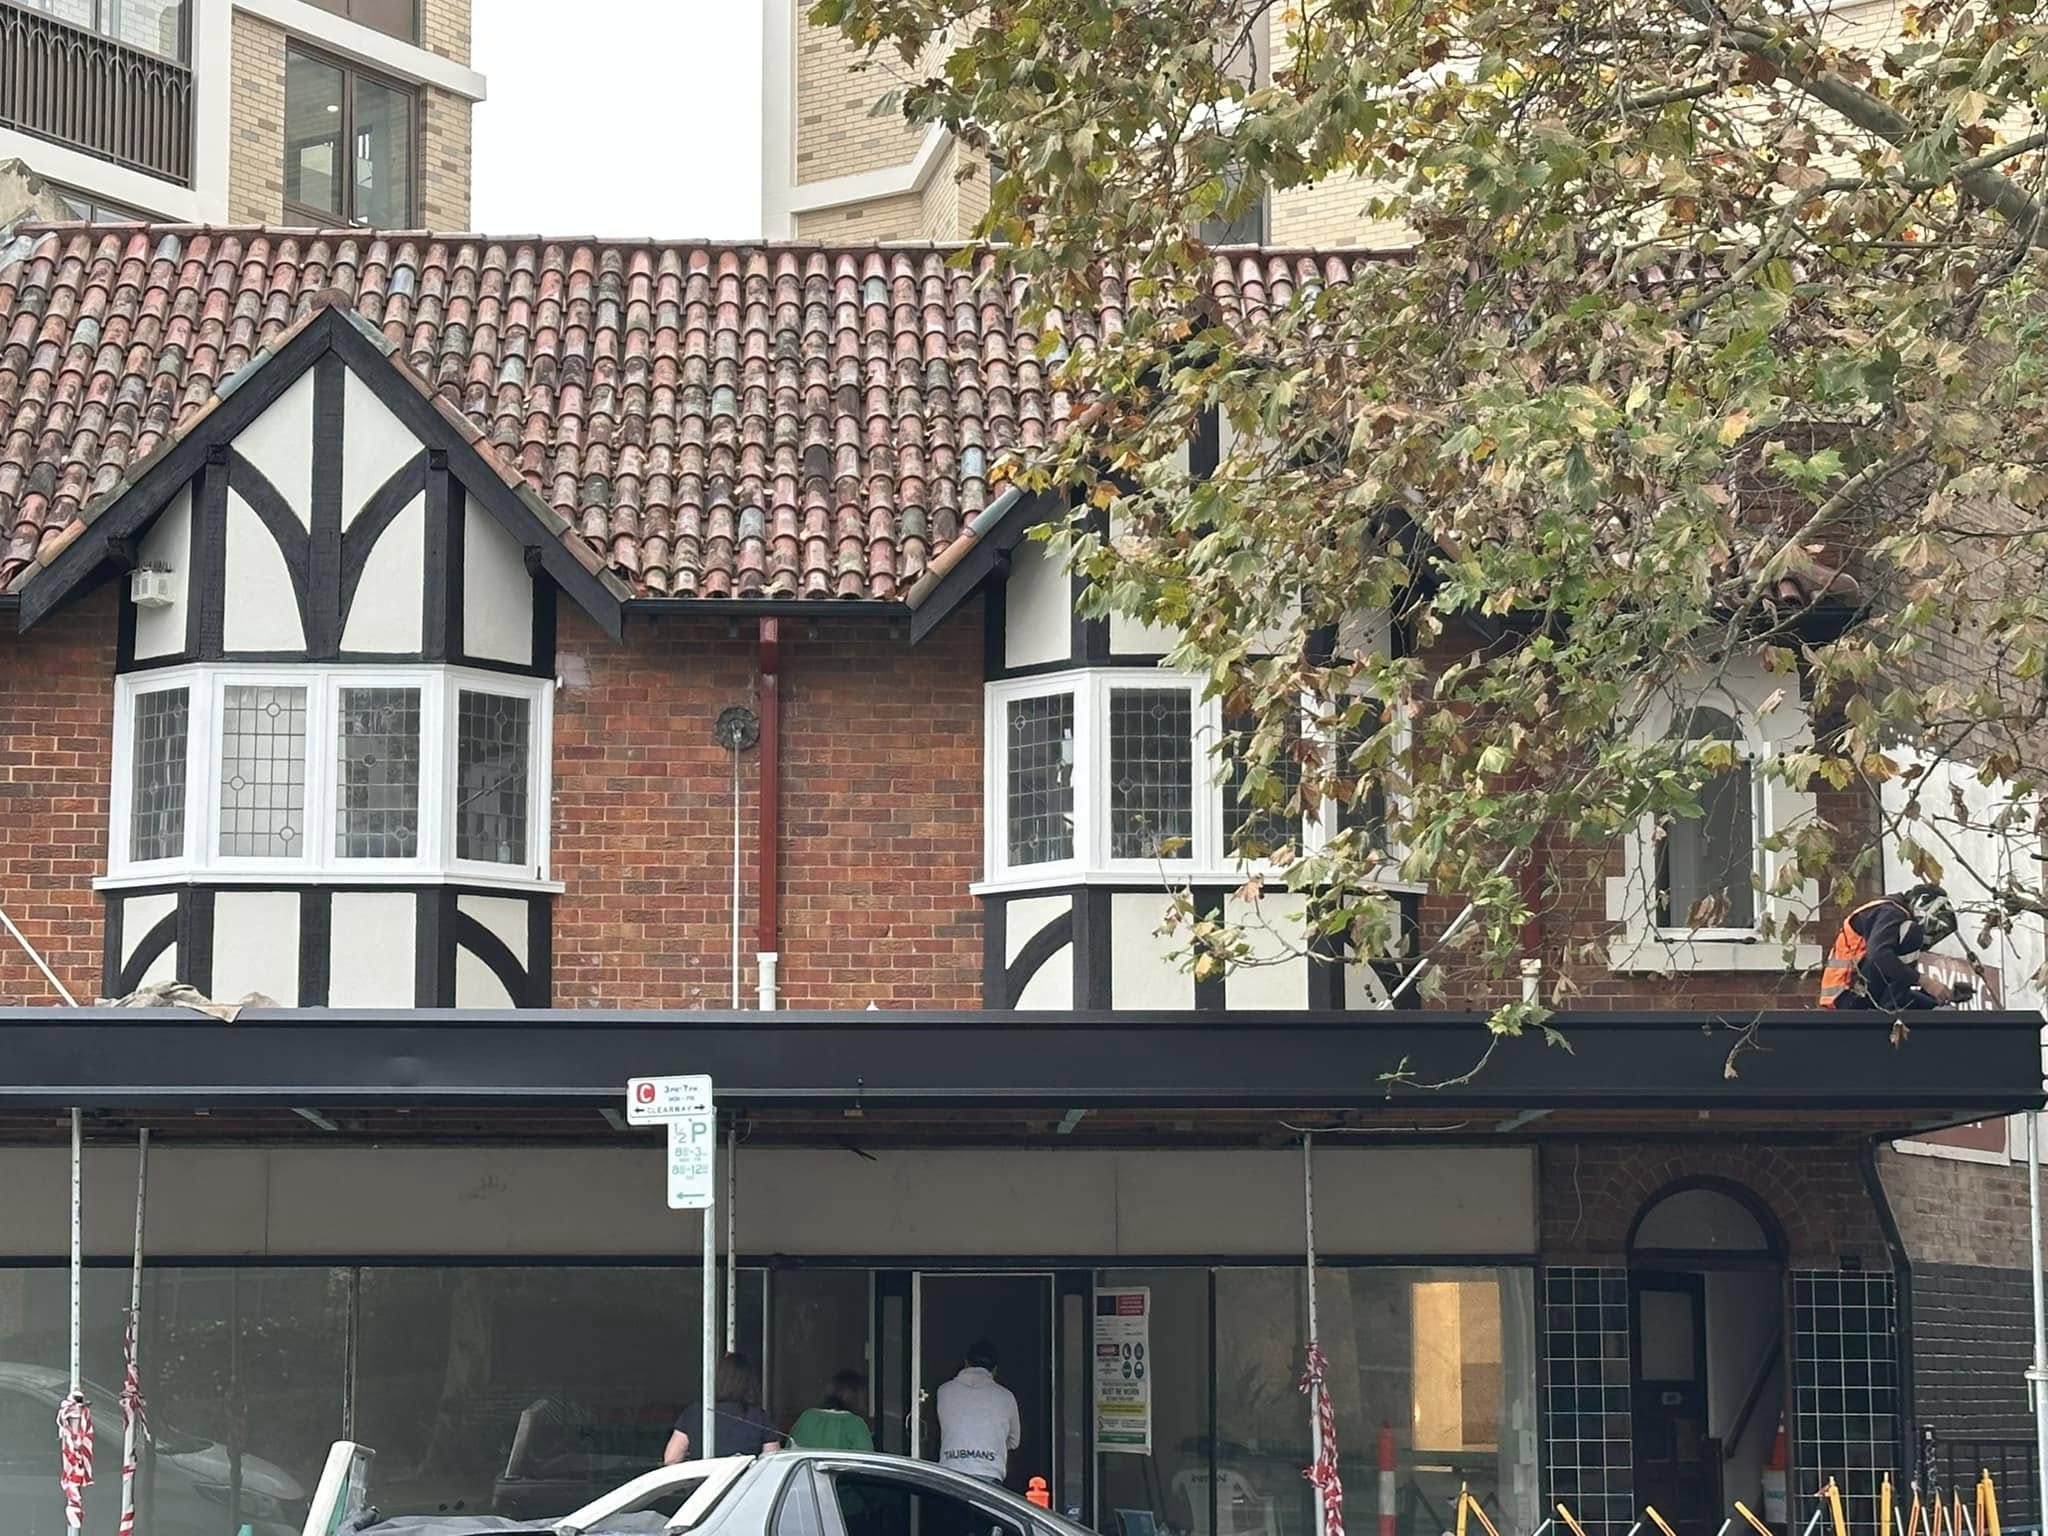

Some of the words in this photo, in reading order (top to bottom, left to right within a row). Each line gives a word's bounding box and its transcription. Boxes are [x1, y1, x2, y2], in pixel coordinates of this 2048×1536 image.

[639, 1084, 654, 1103] C
[646, 1105, 692, 1114] CLEARWAY
[691, 1122, 707, 1143] P
[944, 1449, 995, 1461] TAUBMANS
